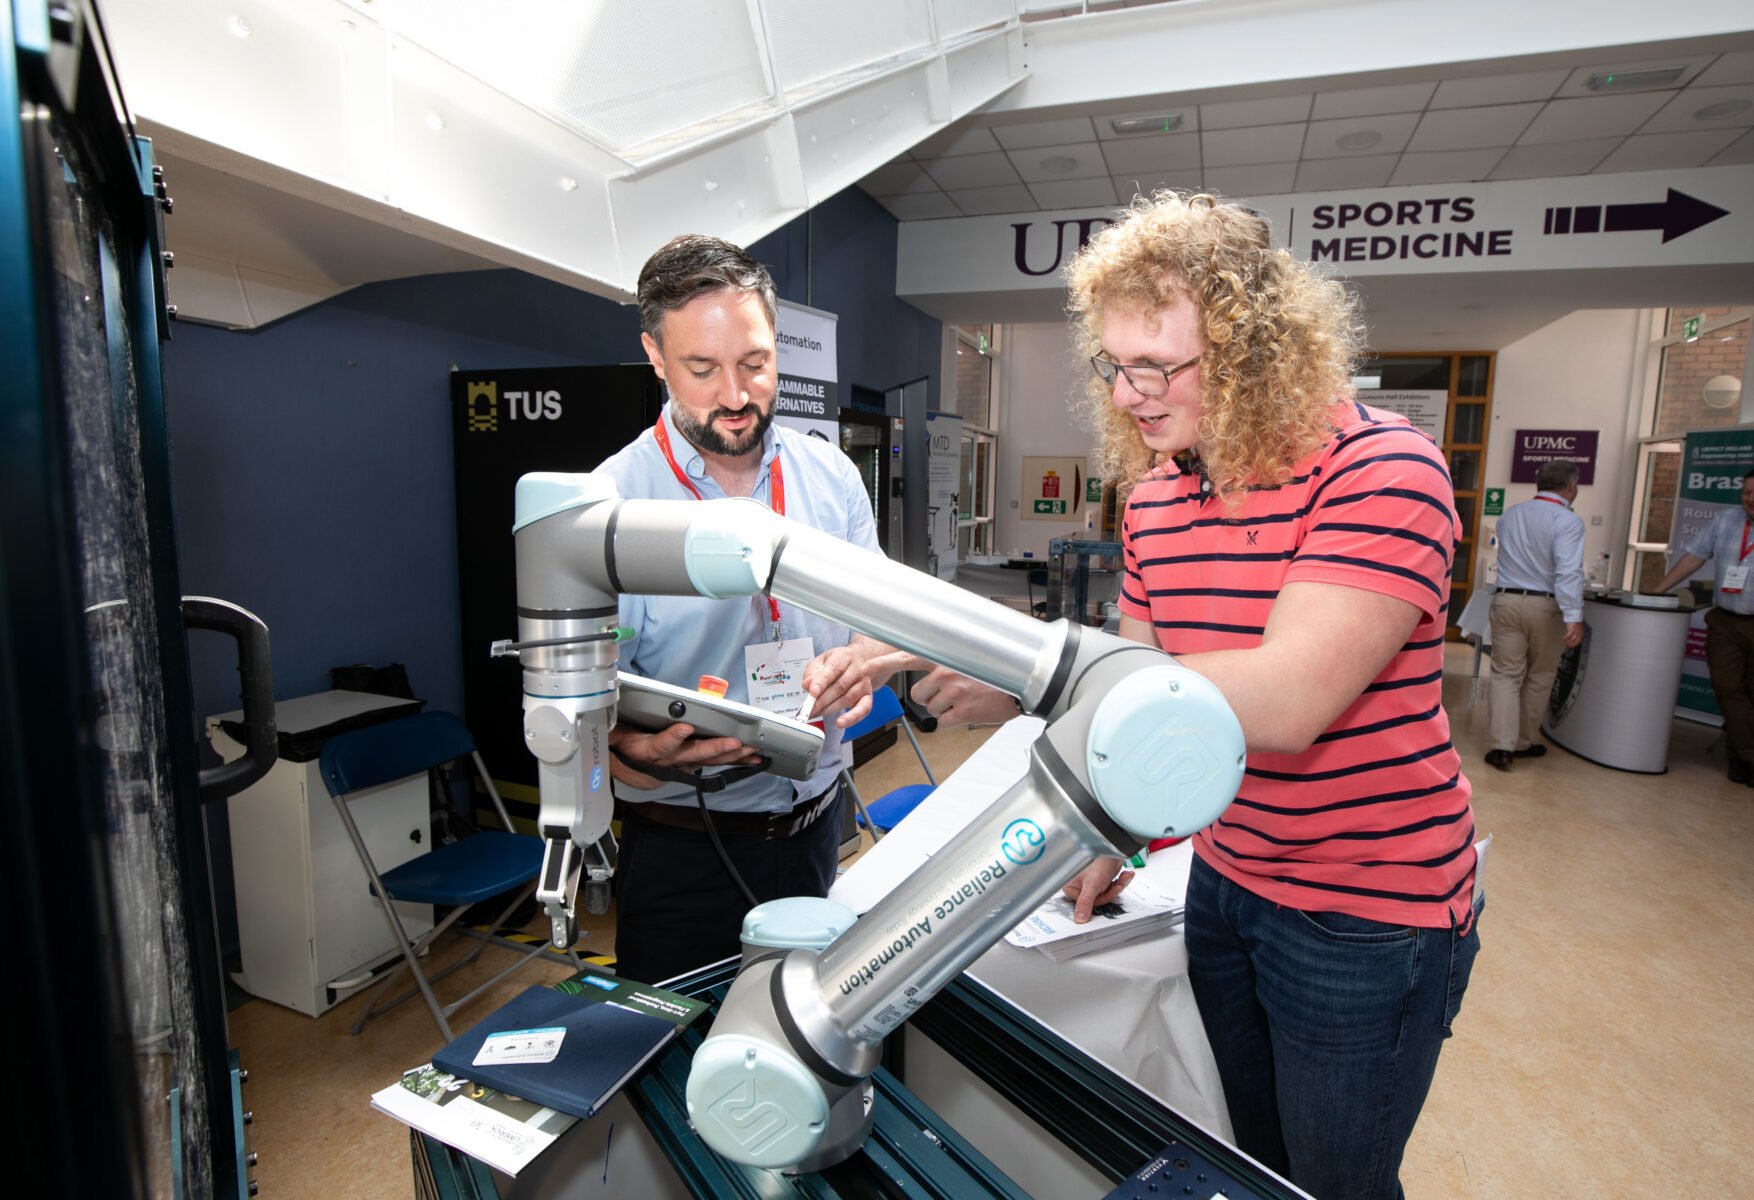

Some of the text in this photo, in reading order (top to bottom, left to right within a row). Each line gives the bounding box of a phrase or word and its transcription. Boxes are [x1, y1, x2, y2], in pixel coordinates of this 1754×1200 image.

[1312, 197, 1475, 230] SPORTS
[1311, 230, 1513, 262] MEDICINE
[777, 379, 825, 398] AMMABLE
[503, 390, 563, 421] TUS
[932, 434, 950, 451] MTD
[1523, 436, 1577, 450] UPMC
[839, 860, 1007, 996] Reliance Automation
